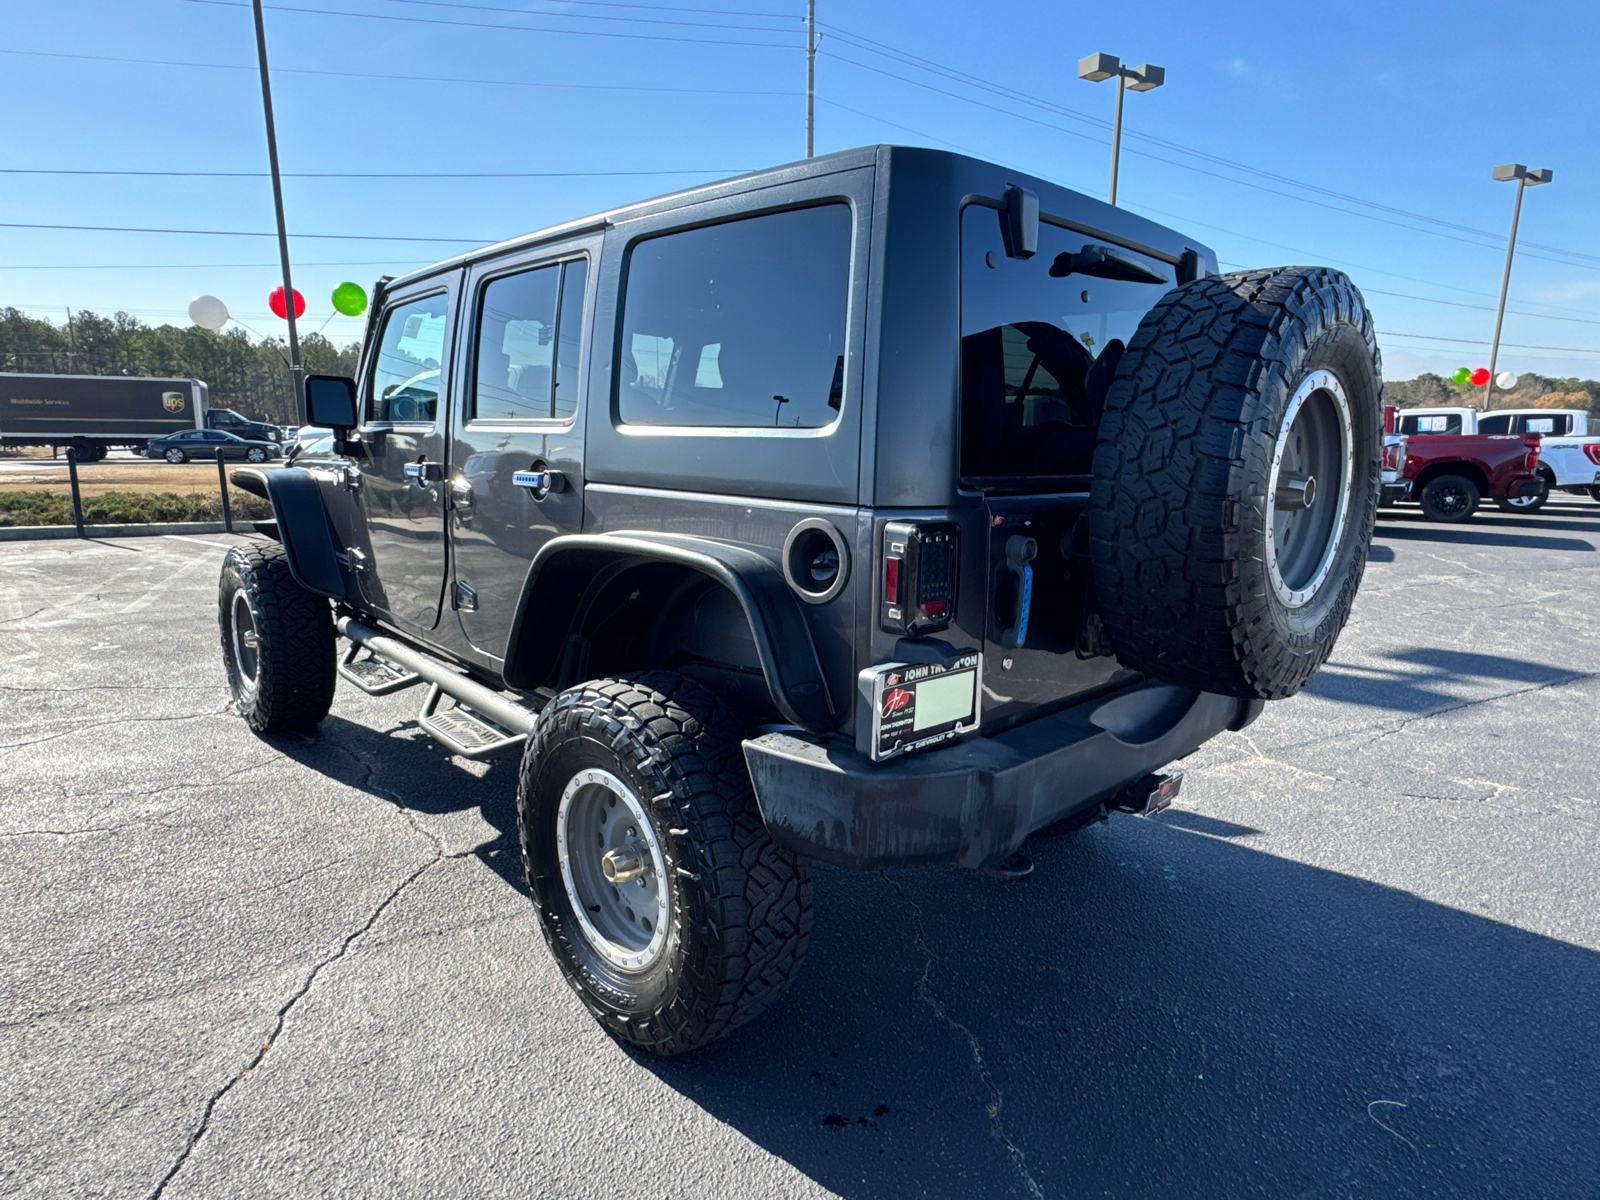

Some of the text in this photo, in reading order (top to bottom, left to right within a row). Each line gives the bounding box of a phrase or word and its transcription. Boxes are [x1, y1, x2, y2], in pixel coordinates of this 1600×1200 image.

[163, 398, 184, 410] ups
[904, 666, 929, 681] JOHN
[930, 655, 978, 674] THNTON
[892, 717, 914, 728] THORNTON
[915, 734, 946, 749] CHEVROLET
